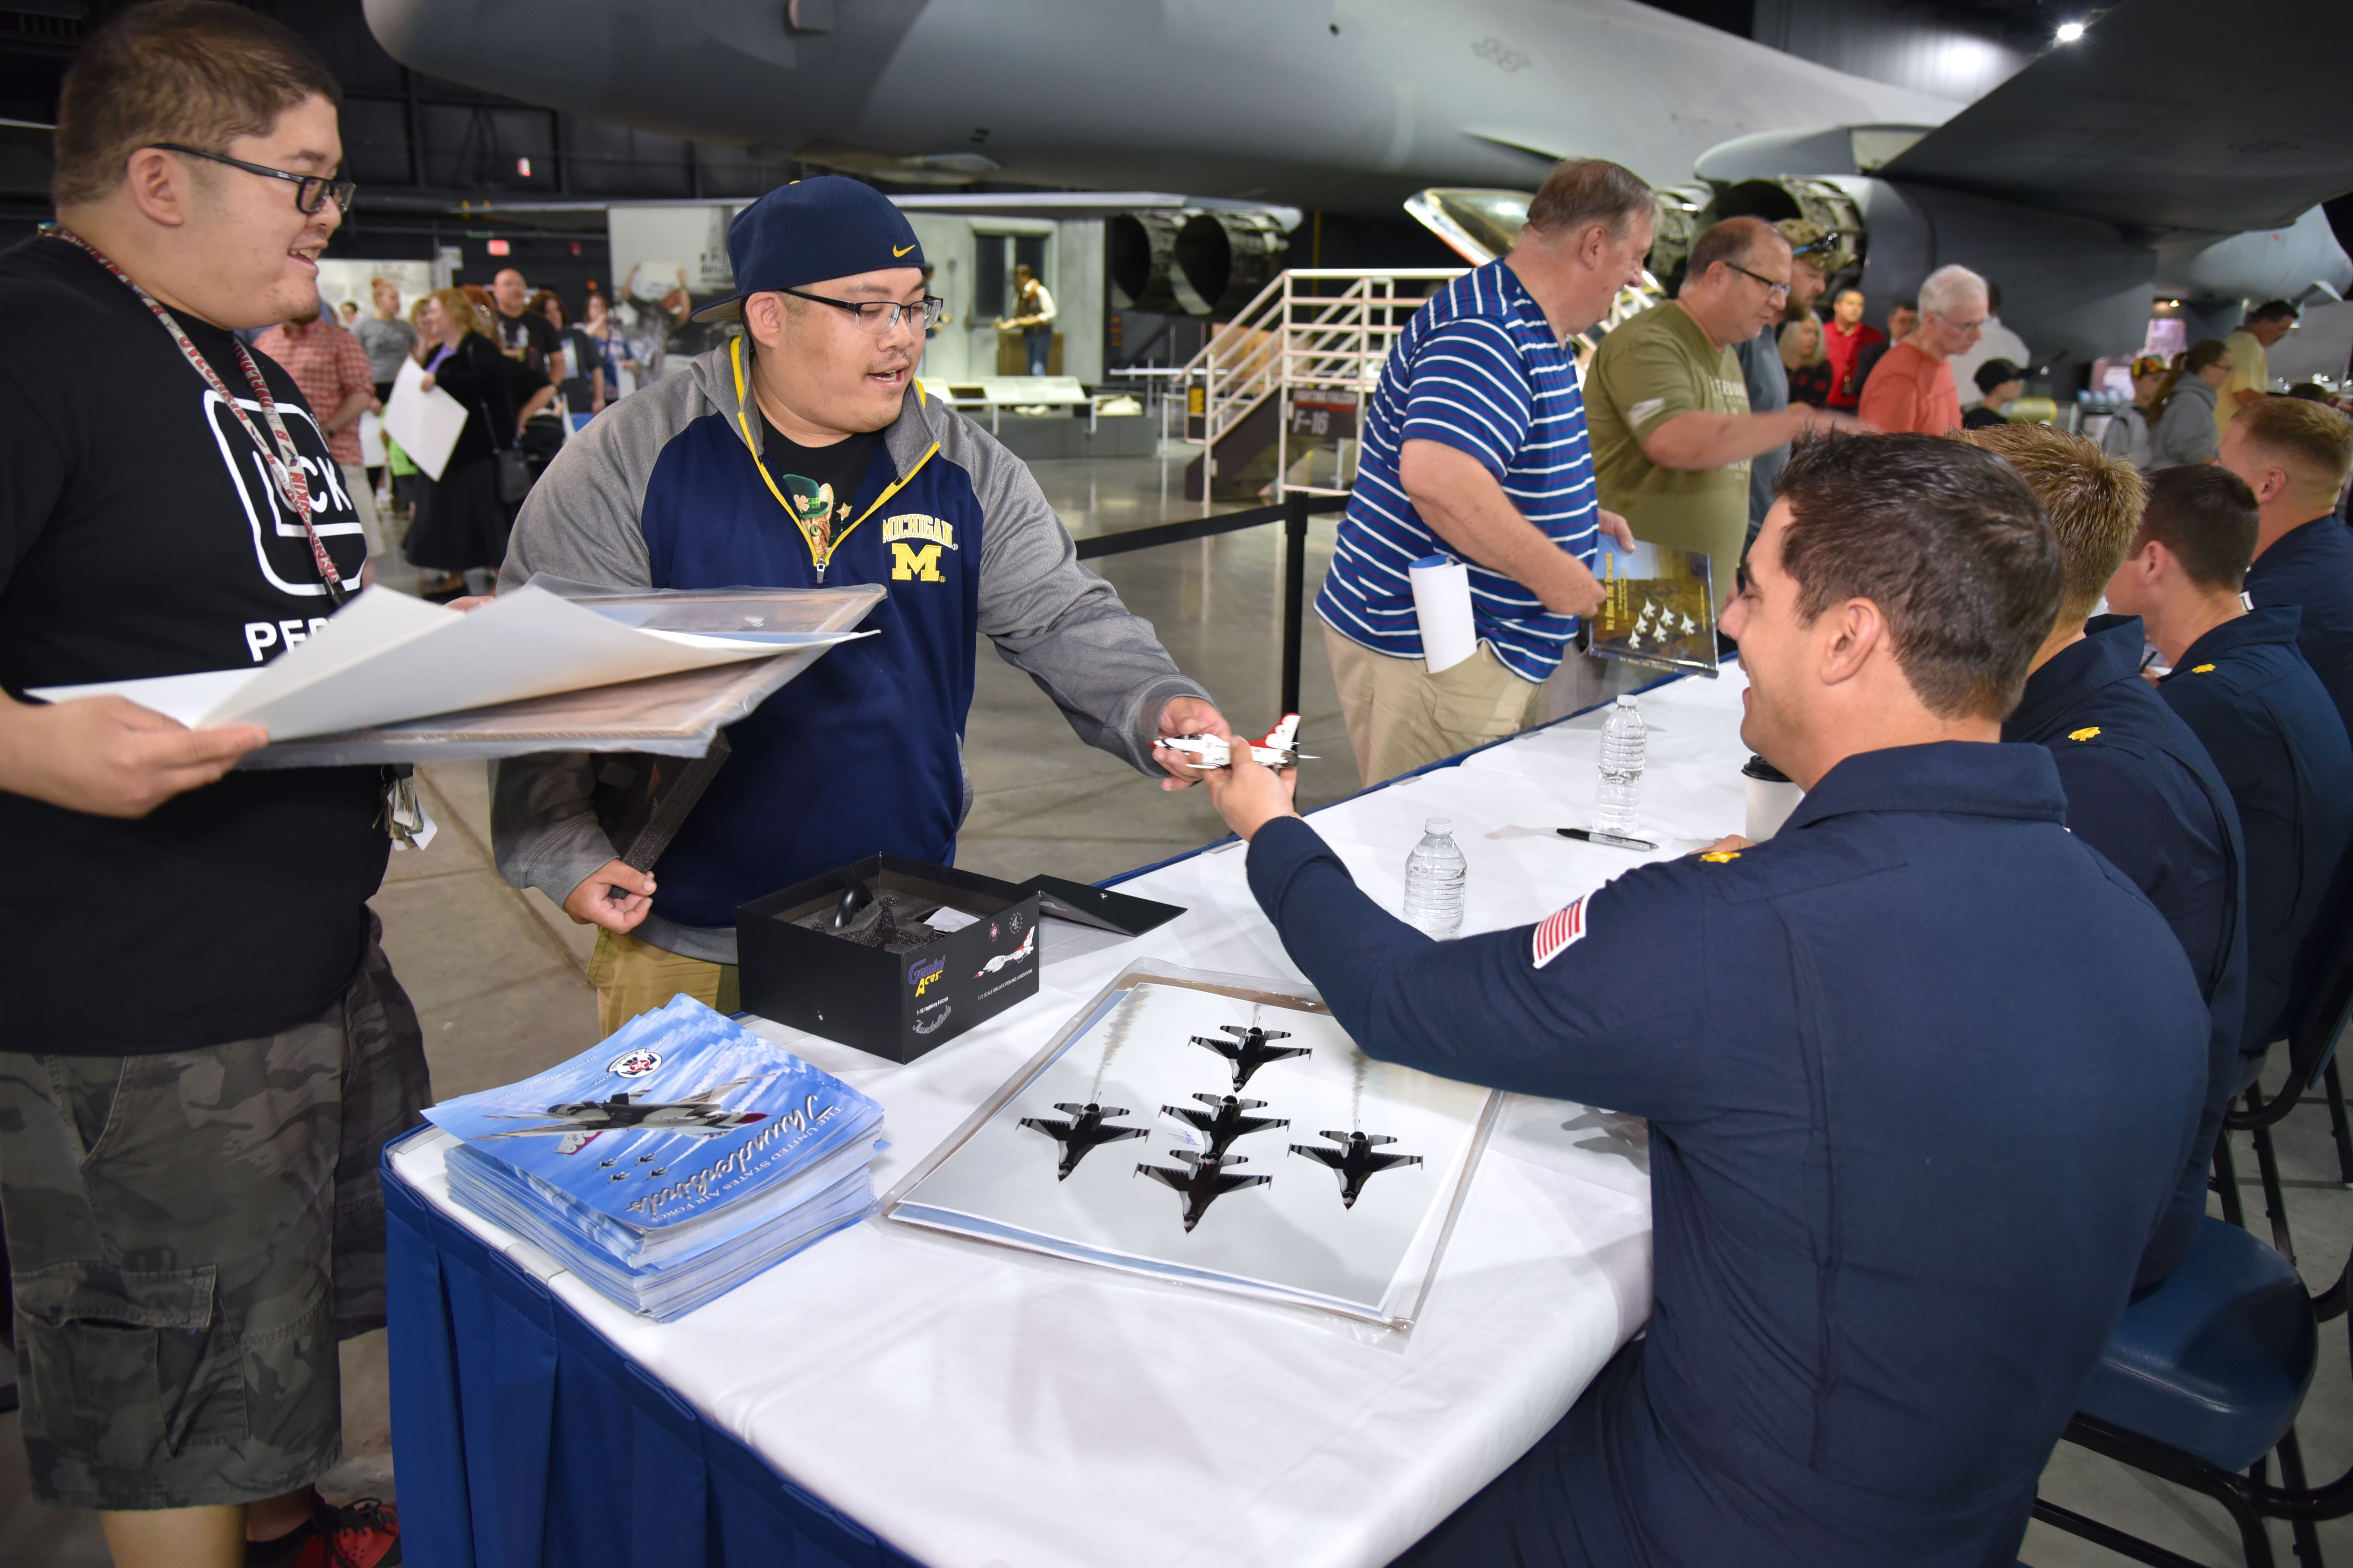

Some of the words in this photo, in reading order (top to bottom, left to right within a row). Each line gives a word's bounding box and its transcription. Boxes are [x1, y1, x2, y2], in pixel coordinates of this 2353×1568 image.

[1292, 409, 1330, 435] F-16
[882, 513, 953, 549] MICHIGAN
[891, 543, 942, 582] M
[908, 955, 946, 985] Gemini
[915, 969, 943, 997] Aces
[924, 1001, 938, 1012] Fighting
[938, 996, 949, 1005] Falcon
[984, 988, 993, 998] SCALE
[816, 1106, 845, 1126] THE
[625, 1094, 834, 1215] Thunderbirds
[771, 1127, 818, 1161] UNITED
[722, 1160, 771, 1190] STATES
[695, 1189, 720, 1205] AIR
[648, 1203, 695, 1223] FORCE
